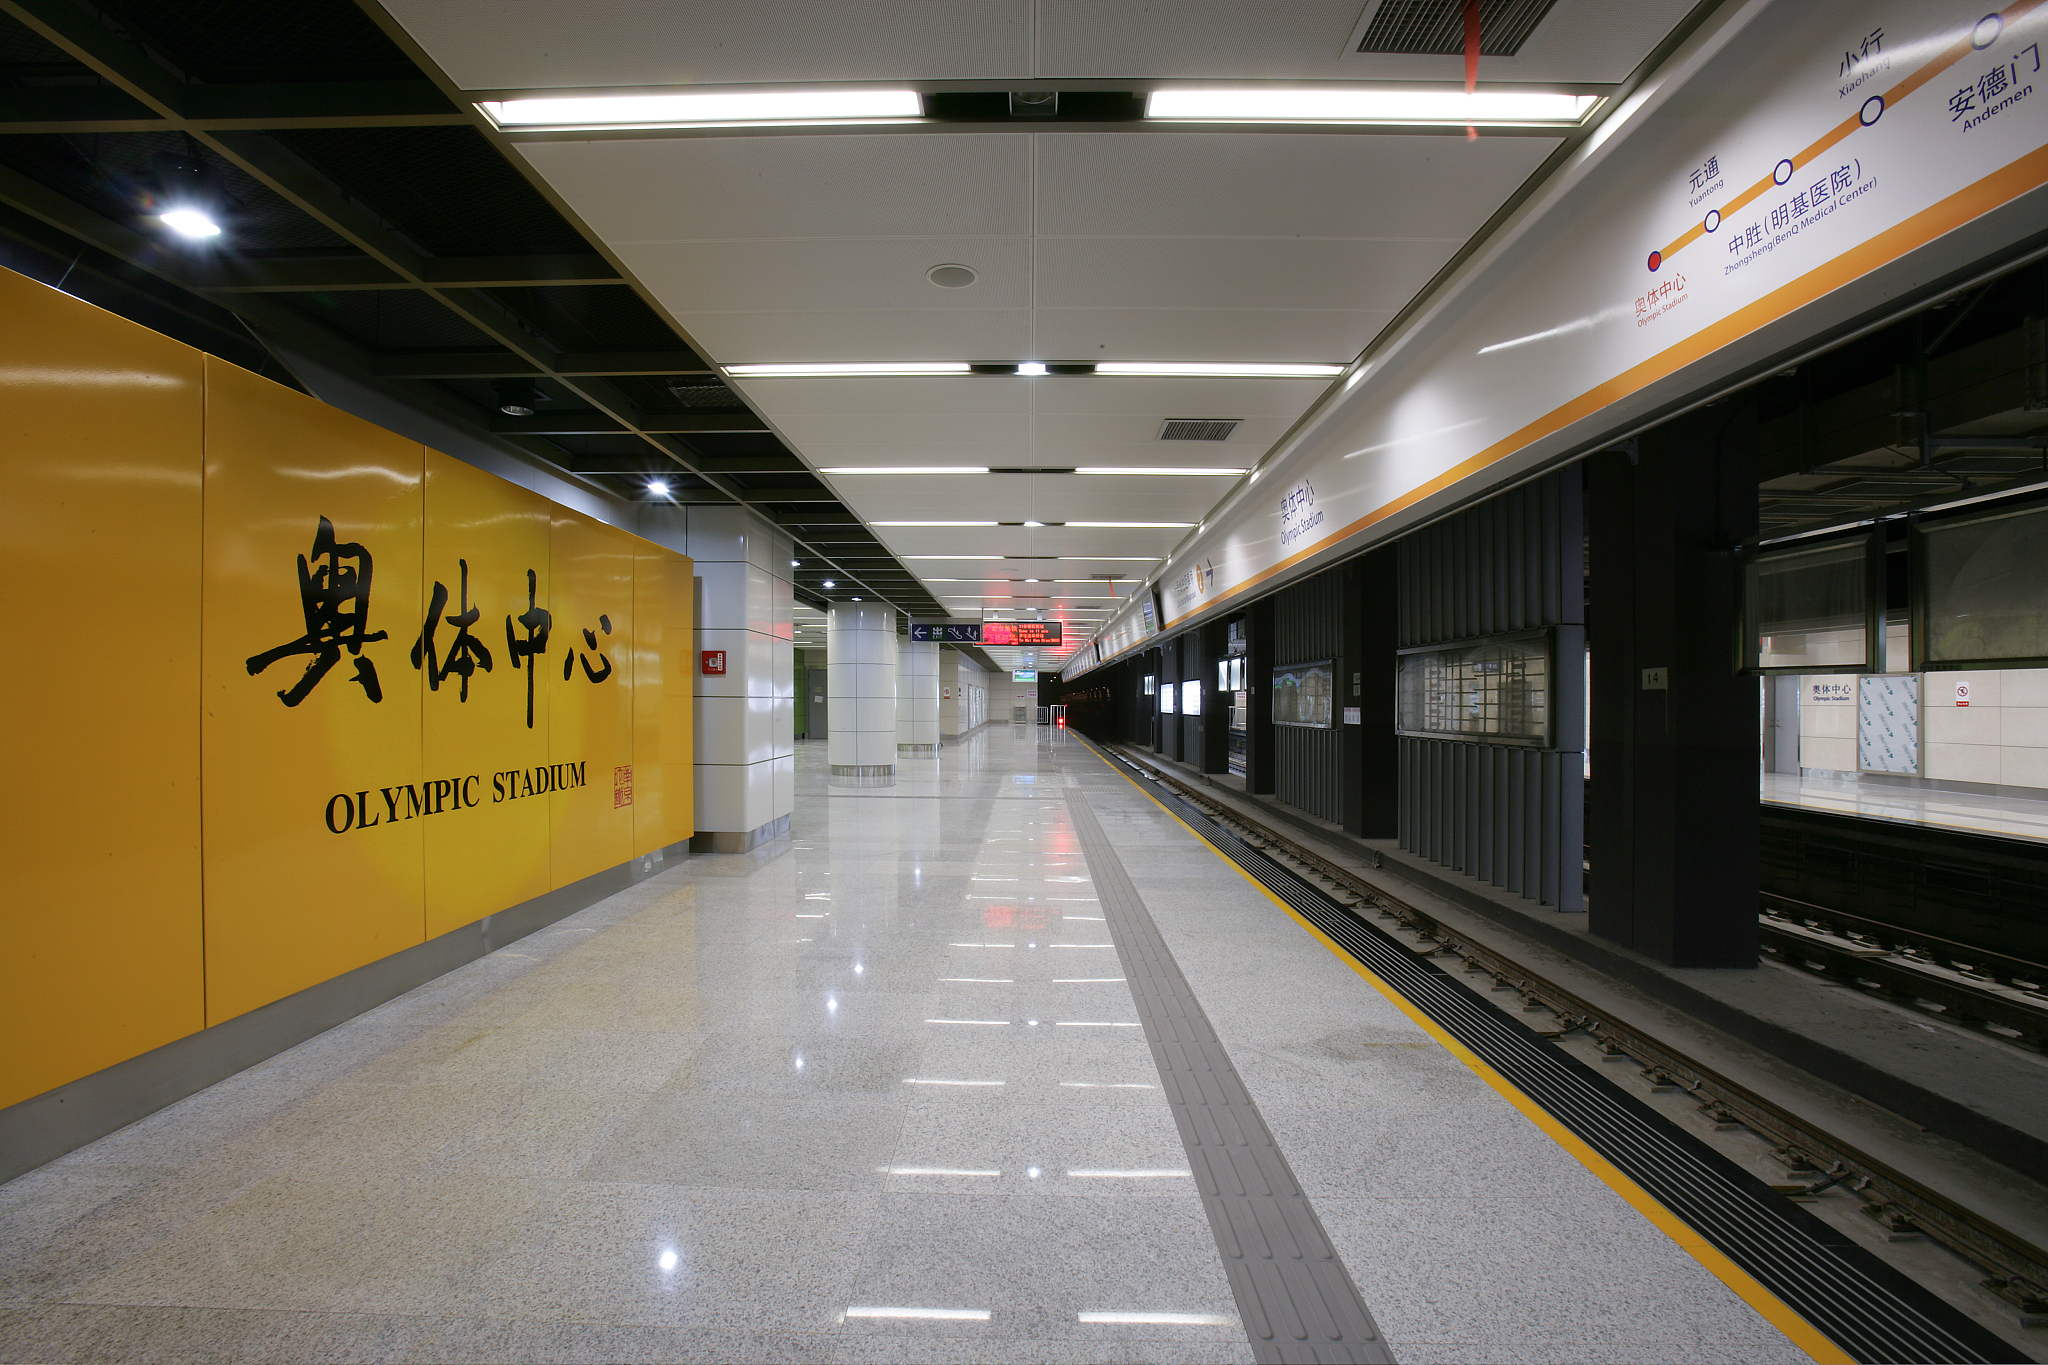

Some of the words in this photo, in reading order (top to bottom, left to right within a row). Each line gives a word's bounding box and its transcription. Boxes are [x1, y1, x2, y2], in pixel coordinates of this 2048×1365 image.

[1838, 27, 1885, 78] 小行
[1838, 55, 1891, 99] Xiaohang
[1948, 42, 2041, 122] 安德门
[1963, 84, 2033, 133] Andemen
[1688, 178, 1724, 207] Yuantong
[1689, 154, 1720, 194] 元通
[1724, 224, 1799, 275] Zhongsheng(BenQ
[1800, 200, 1837, 231] Medical
[1838, 176, 1878, 207] Center)
[1634, 272, 1687, 317] 奥体中心
[1637, 305, 1662, 328] Olympic
[1662, 292, 1689, 314] Stadium
[1281, 479, 1315, 524] 奥体中心
[1281, 524, 1301, 546] Olympic
[1301, 511, 1324, 533] Stadium
[245, 514, 613, 729] 奥体中心
[1646, 671, 1659, 684] 14
[1812, 684, 1852, 695] 奥体中心
[325, 774, 480, 834] OLYMPIC
[492, 761, 587, 804] STADIUM
